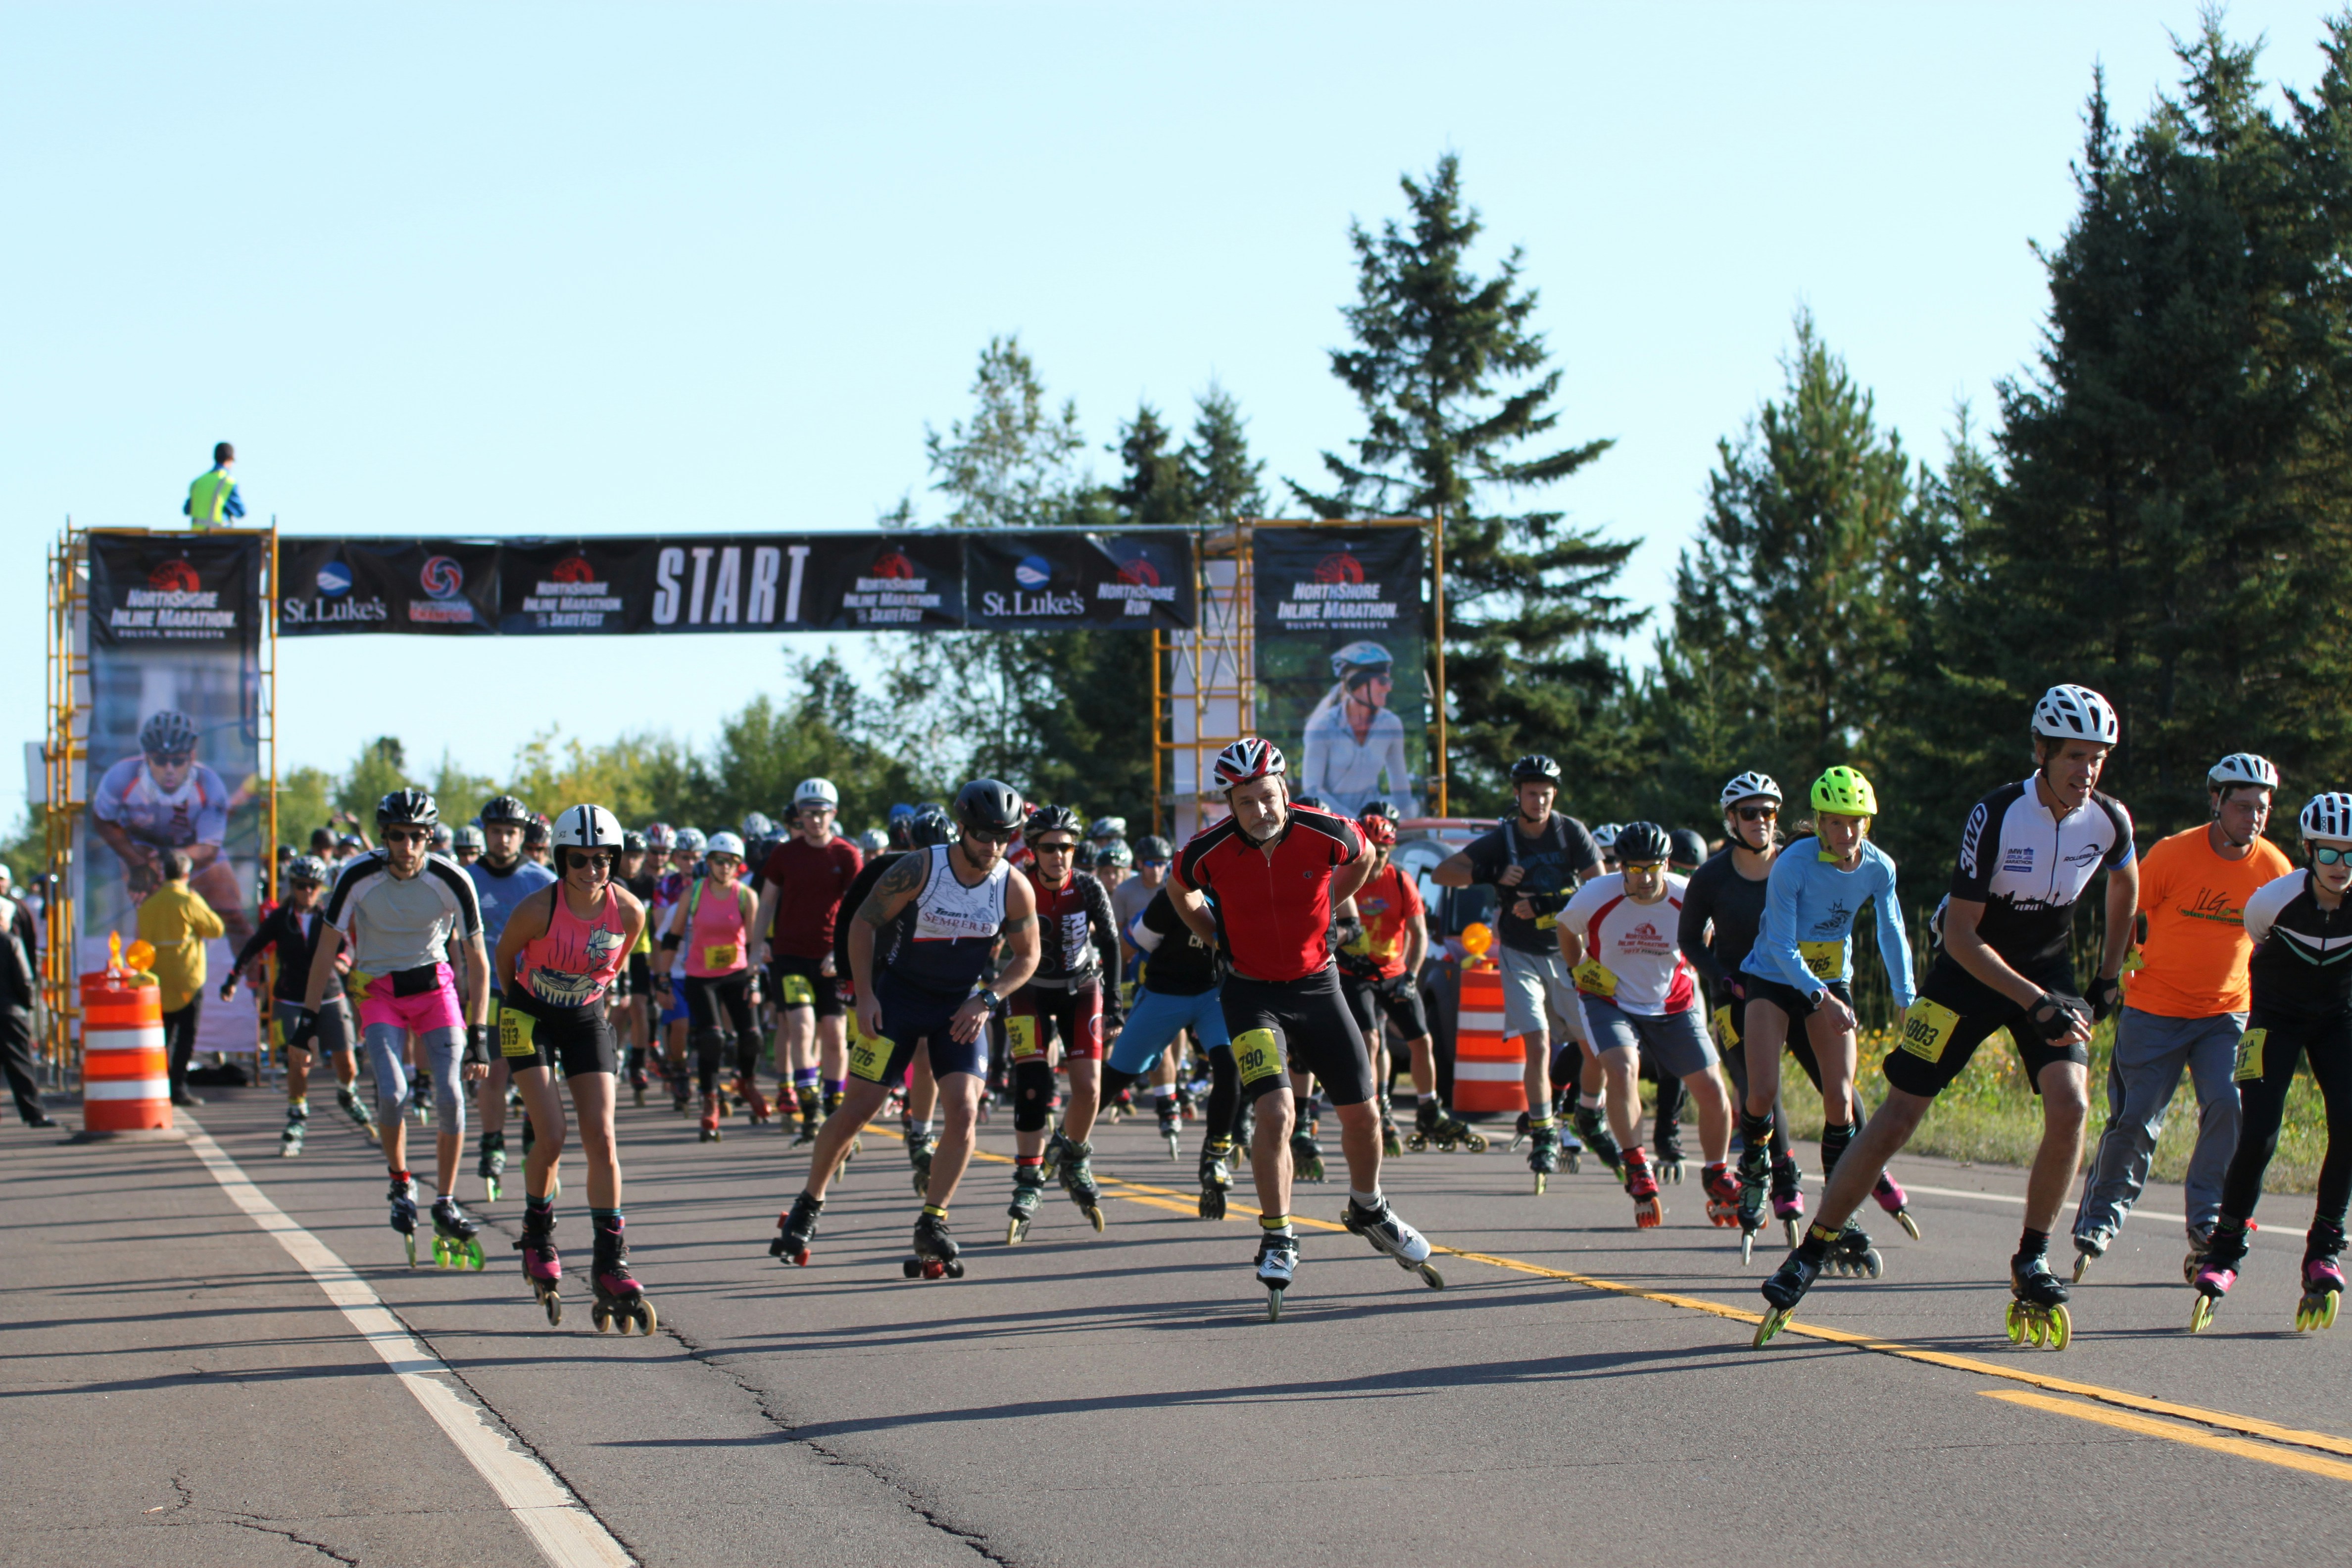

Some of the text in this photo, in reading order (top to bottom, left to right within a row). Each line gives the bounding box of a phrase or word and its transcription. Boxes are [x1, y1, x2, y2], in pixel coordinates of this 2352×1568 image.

[652, 547, 811, 625] START
[284, 595, 387, 623] St. Luke's
[560, 597, 622, 611] MARATHON
[879, 593, 940, 608] MARATHON
[982, 589, 1085, 616] St. Luke's
[1124, 600, 1151, 616] RUN
[1277, 600, 1397, 619] INLINE MARATHON
[110, 607, 235, 628] INLINE MARATHON
[2063, 848, 2106, 862] ROLLERBLADE
[923, 912, 977, 931] SEMPER
[935, 907, 969, 919] Team
[1637, 940, 1669, 948] MARATHON
[1807, 956, 1830, 973] 765
[1906, 1017, 1939, 1046] 1003
[1239, 1049, 1263, 1075] 790
